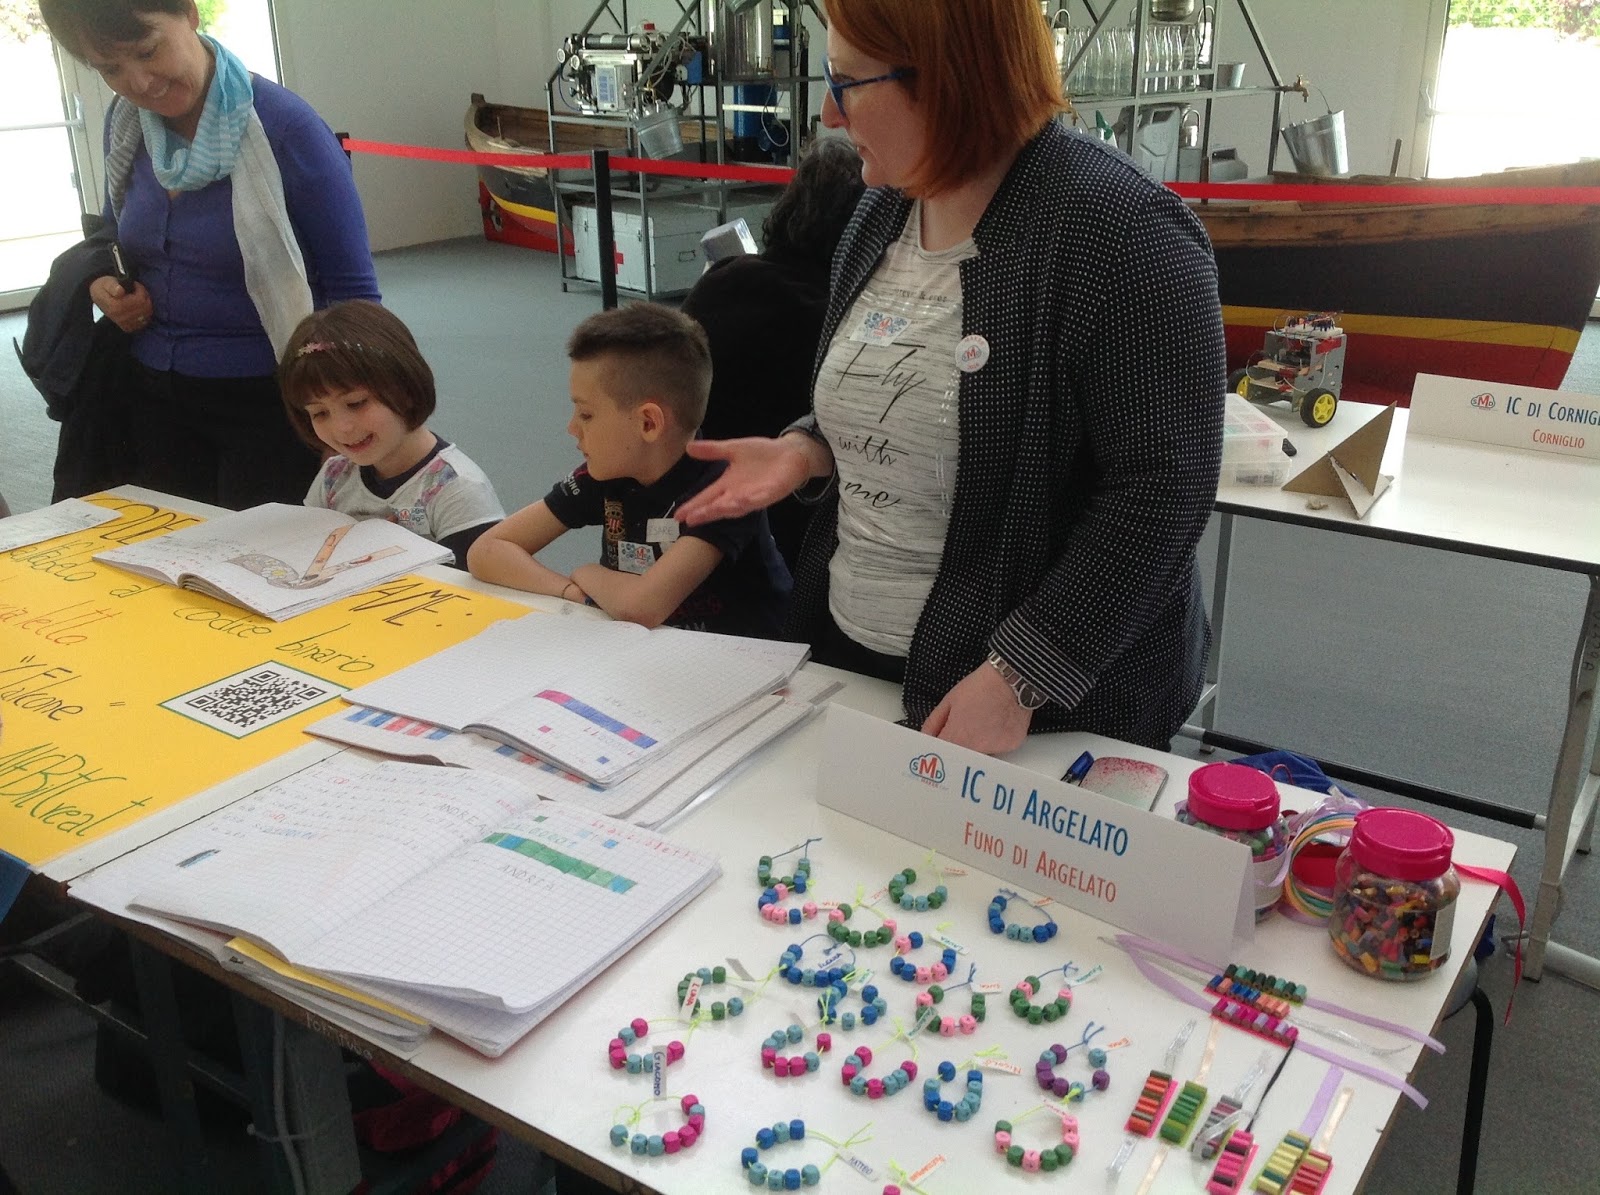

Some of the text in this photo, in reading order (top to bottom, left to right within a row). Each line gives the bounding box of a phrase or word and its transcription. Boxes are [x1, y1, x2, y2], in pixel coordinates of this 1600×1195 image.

[1506, 396, 1522, 415] IC
[1527, 402, 1542, 418] DI
[838, 435, 910, 466] with
[1533, 429, 1585, 449] CORNIGLIO
[844, 481, 901, 509] me
[275, 622, 375, 674] binario
[960, 765, 1129, 857] IC DI ARGELATO
[963, 821, 1117, 903] FUNO DI ARGELATO
